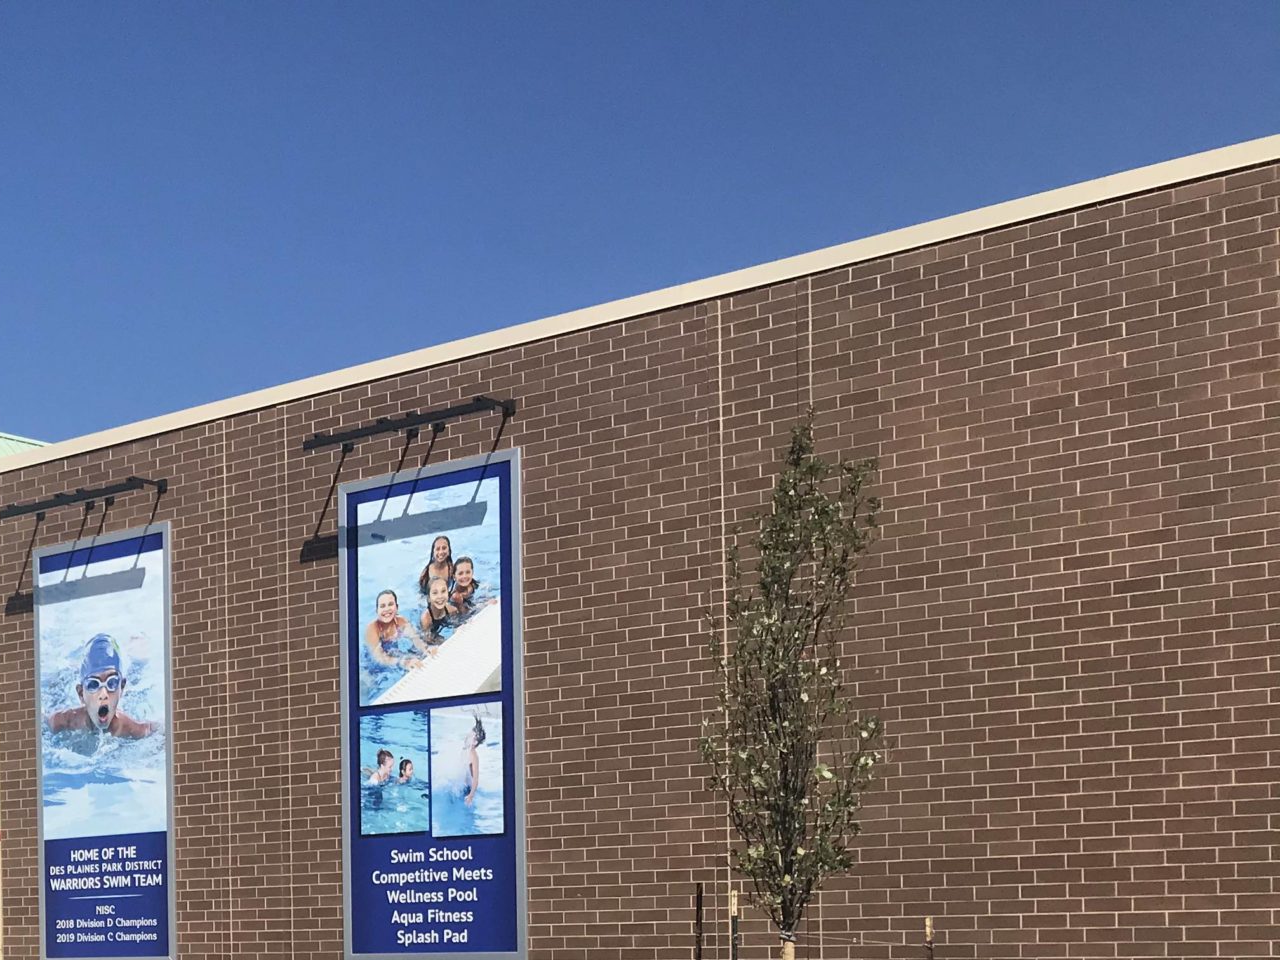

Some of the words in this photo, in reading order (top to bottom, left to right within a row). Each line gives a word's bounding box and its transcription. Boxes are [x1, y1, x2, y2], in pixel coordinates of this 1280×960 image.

[70, 848, 99, 862] HOME
[101, 847, 115, 860] OF
[117, 846, 137, 859] THE
[390, 849, 425, 863] Swim
[428, 846, 473, 862] School
[50, 866, 65, 876] DES
[67, 864, 100, 875] PLAINES
[102, 862, 123, 872] PARK
[125, 860, 163, 871] DISTRICT
[372, 869, 449, 886] Competitive
[452, 867, 493, 881] Meets
[50, 877, 101, 891] WARRIORS
[103, 875, 131, 888] SWIM
[133, 874, 163, 886] TEAM
[387, 889, 444, 904] Wellness
[448, 887, 478, 902] Pool
[95, 905, 116, 915] NISC
[391, 910, 423, 926] Aqua
[427, 909, 474, 923] Fitness
[56, 919, 74, 929] 2018
[76, 918, 105, 928] Division
[107, 918, 114, 927] D
[115, 917, 158, 929] Champions
[56, 933, 75, 943] 2019
[76, 933, 106, 942] Division
[107, 932, 114, 941] C
[115, 931, 158, 943] Champions
[397, 929, 439, 947] Splash
[443, 929, 468, 943] Pad
